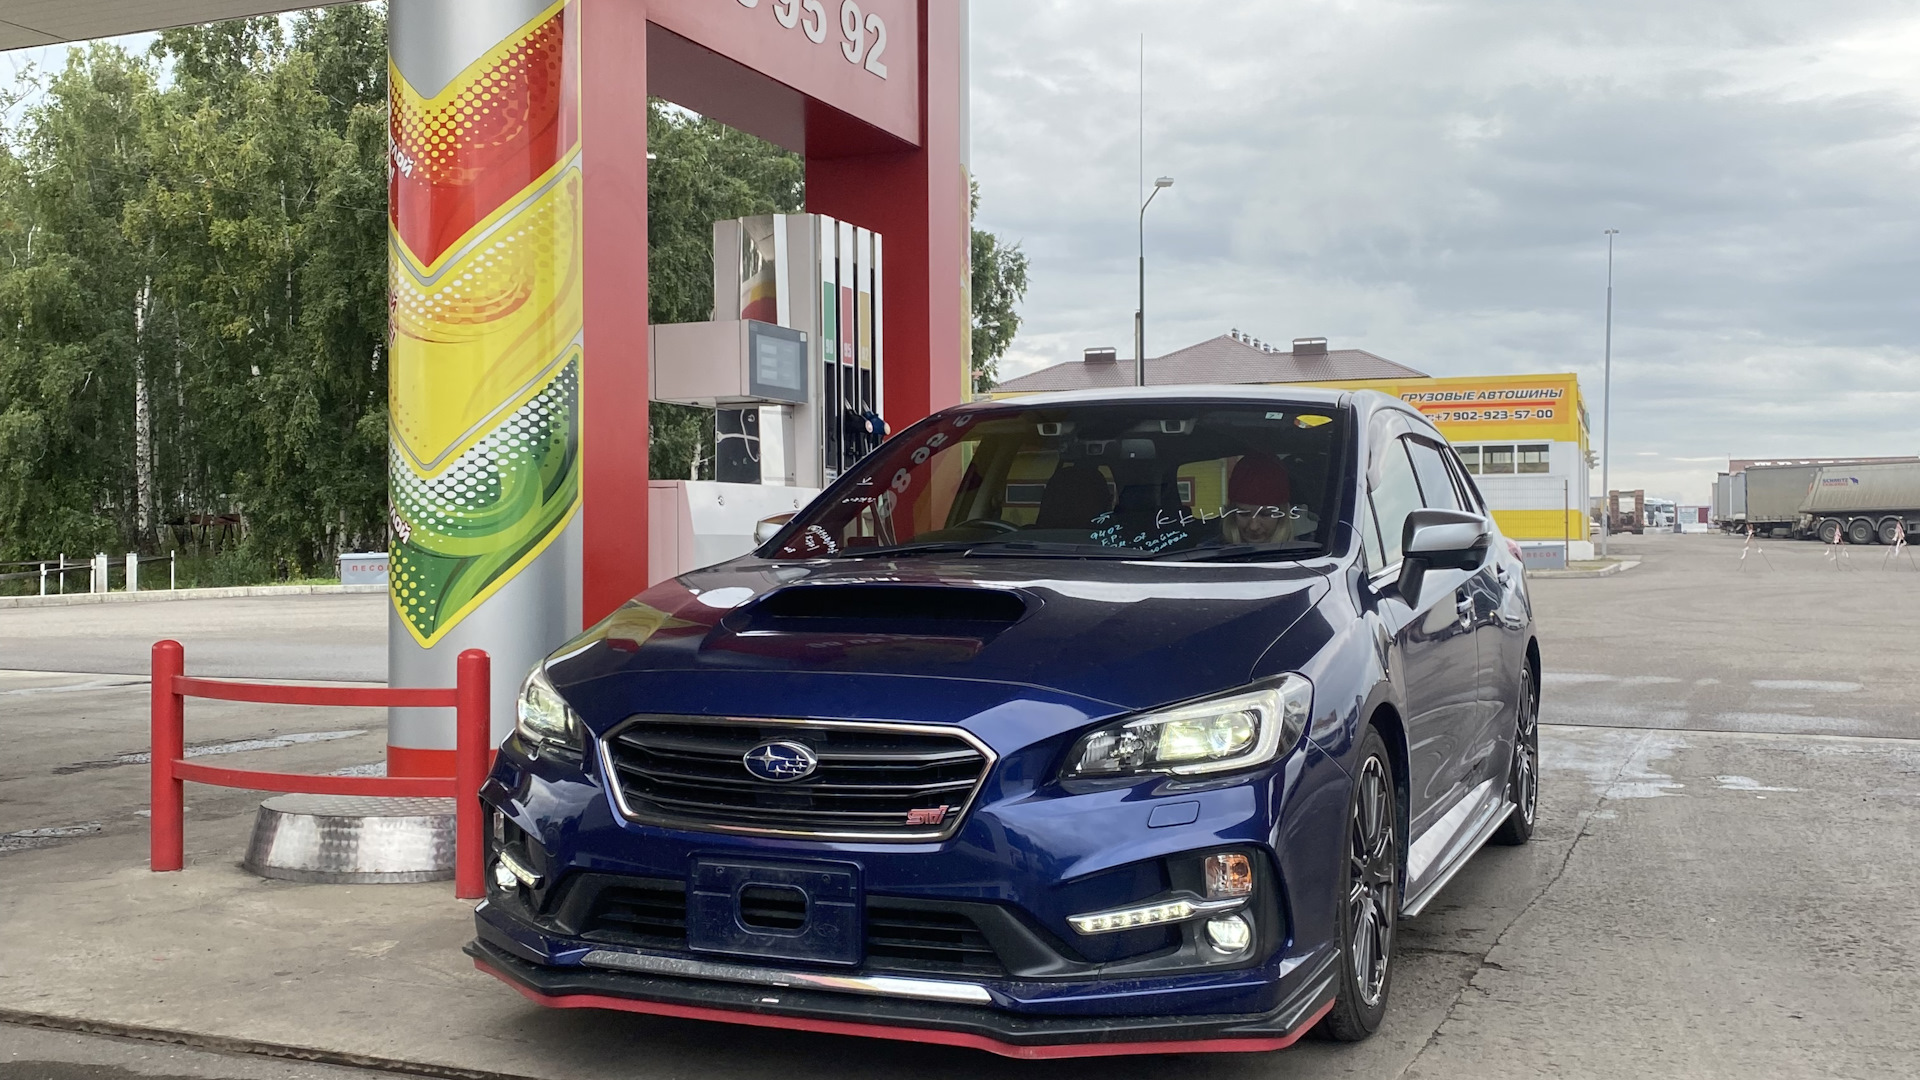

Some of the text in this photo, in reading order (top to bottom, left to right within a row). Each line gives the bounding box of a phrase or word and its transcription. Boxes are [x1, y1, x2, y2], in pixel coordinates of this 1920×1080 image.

[839, 0, 888, 80] 92
[1401, 389, 1563, 402] ГРУЗОВЫЕ АВТОШИНЫ
[1453, 409, 1553, 421] 902-923-57-00
